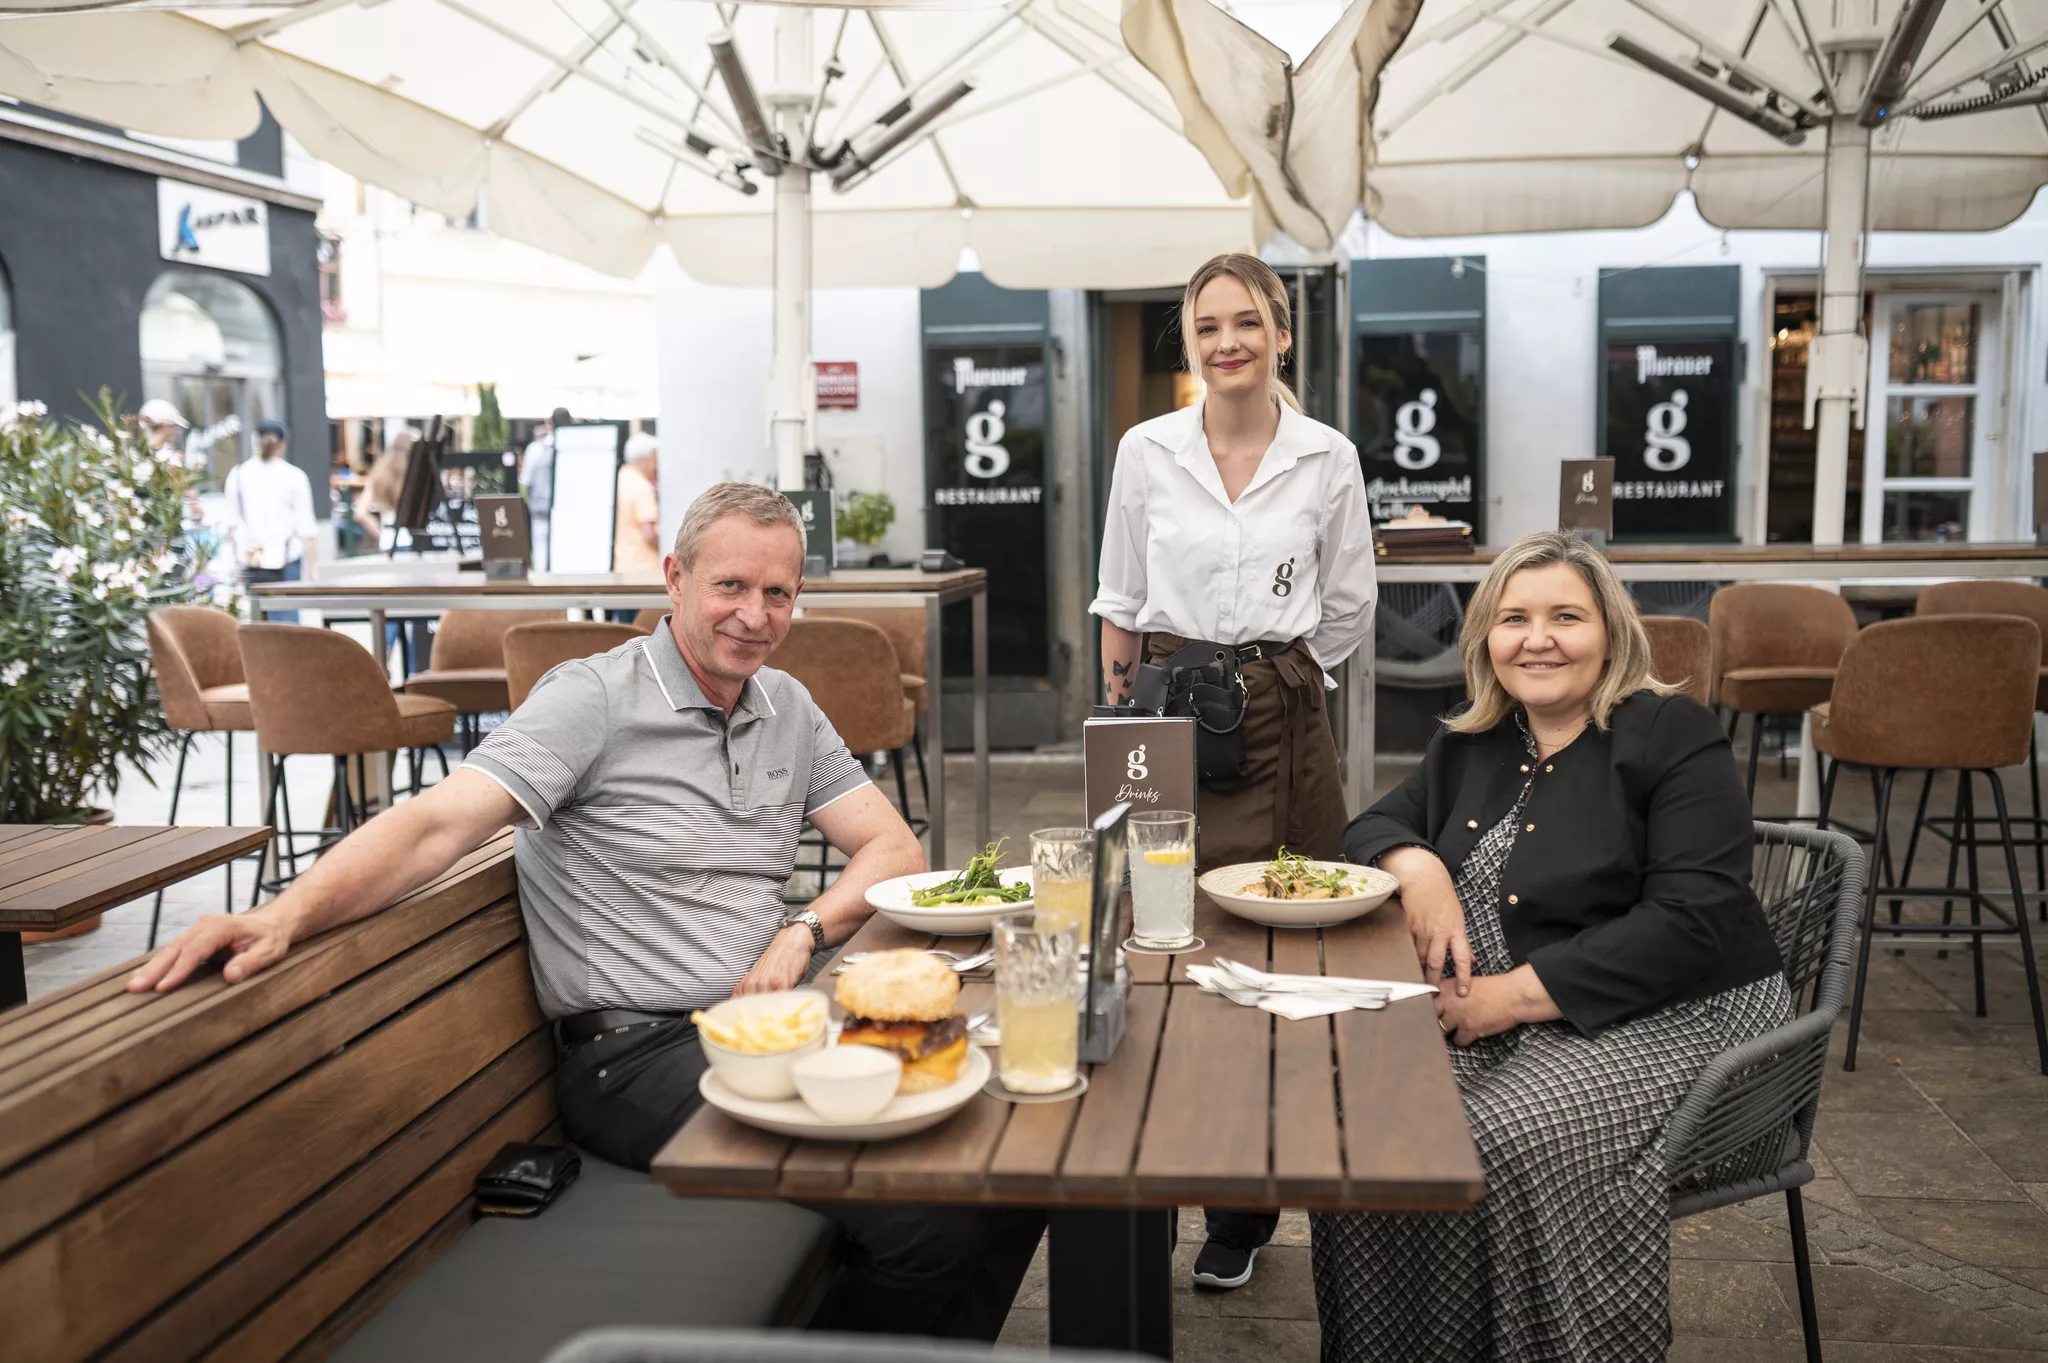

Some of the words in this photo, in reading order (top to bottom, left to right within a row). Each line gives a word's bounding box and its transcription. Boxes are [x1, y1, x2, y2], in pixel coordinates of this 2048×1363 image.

[1636, 344, 1713, 384] Murauer
[964, 399, 1010, 478] g
[1393, 388, 1440, 470] g
[1643, 388, 1691, 471] g
[935, 487, 1041, 505] RESTAURANT
[1611, 480, 1724, 499] RESTAURANT
[1272, 557, 1295, 597] g
[766, 767, 788, 779] BOSS
[1127, 744, 1148, 780] g
[1115, 784, 1161, 803] Drinks
